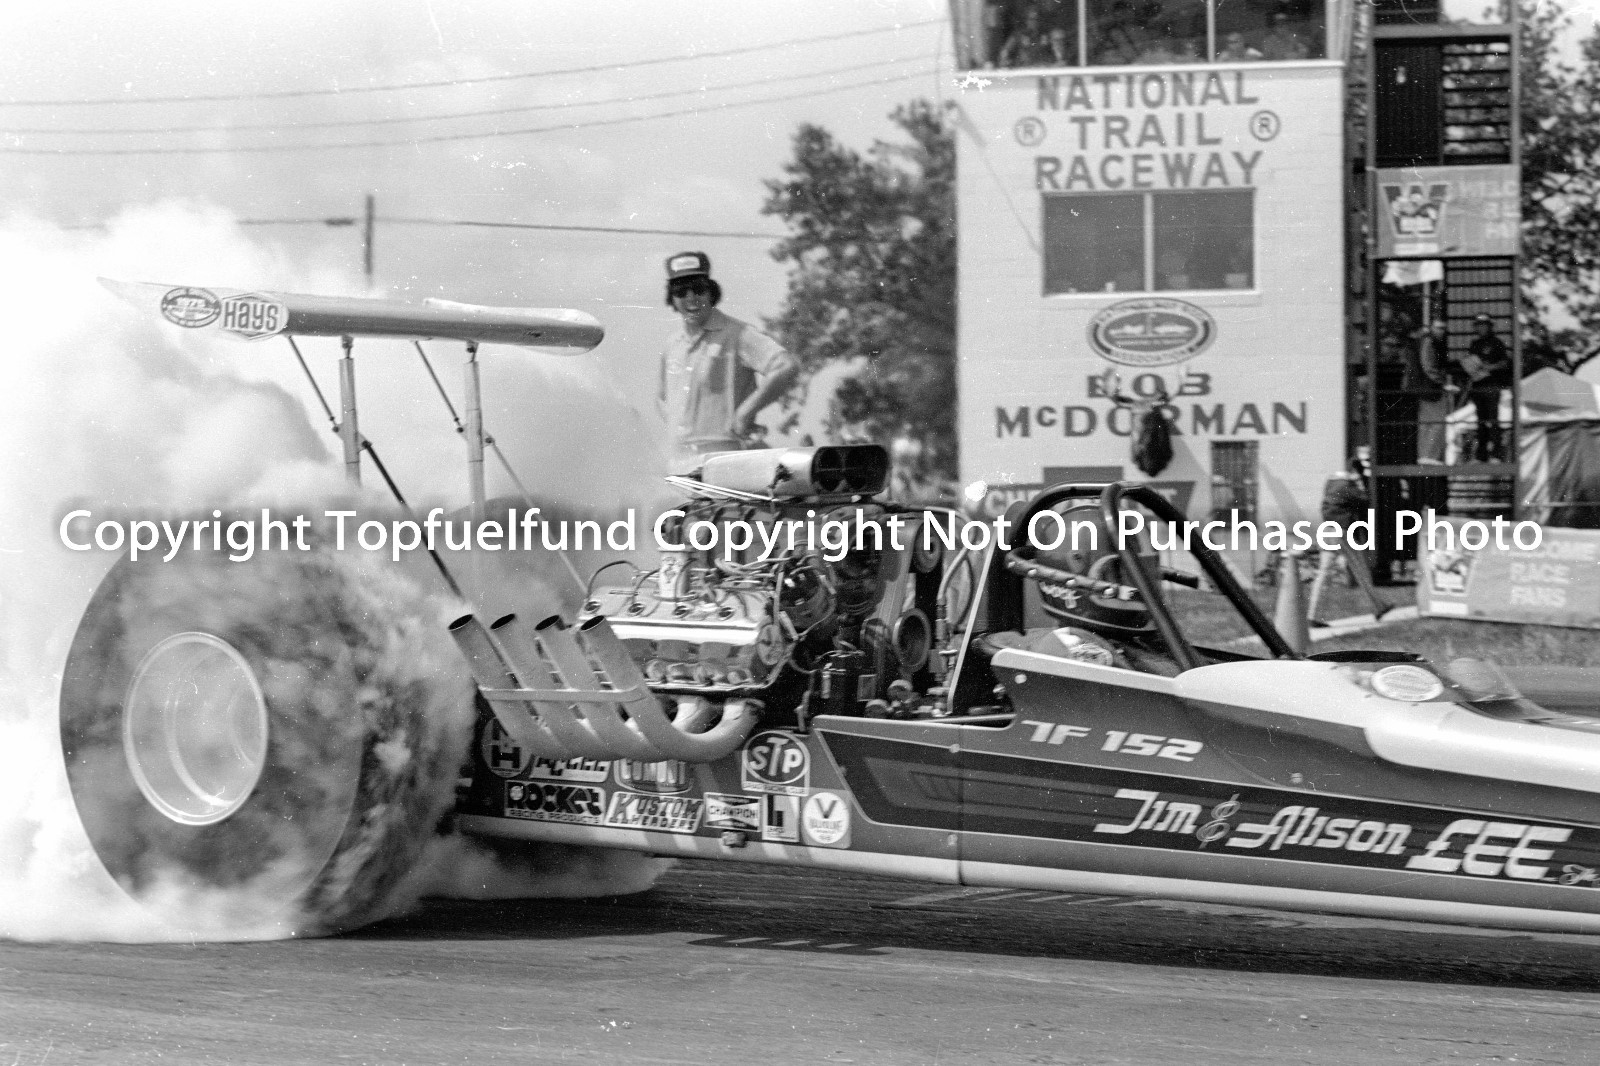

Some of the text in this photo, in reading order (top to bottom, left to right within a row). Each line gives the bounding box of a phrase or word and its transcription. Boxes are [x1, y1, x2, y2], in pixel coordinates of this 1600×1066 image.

[1036, 71, 1259, 110] NATIONAL
[1070, 112, 1222, 150] TRAIL
[1035, 151, 1263, 190] RACEWAY
[223, 300, 279, 331] Hays
[749, 736, 804, 777] STP
[1020, 719, 1204, 762] TF 152
[1093, 788, 1203, 834] Jim
